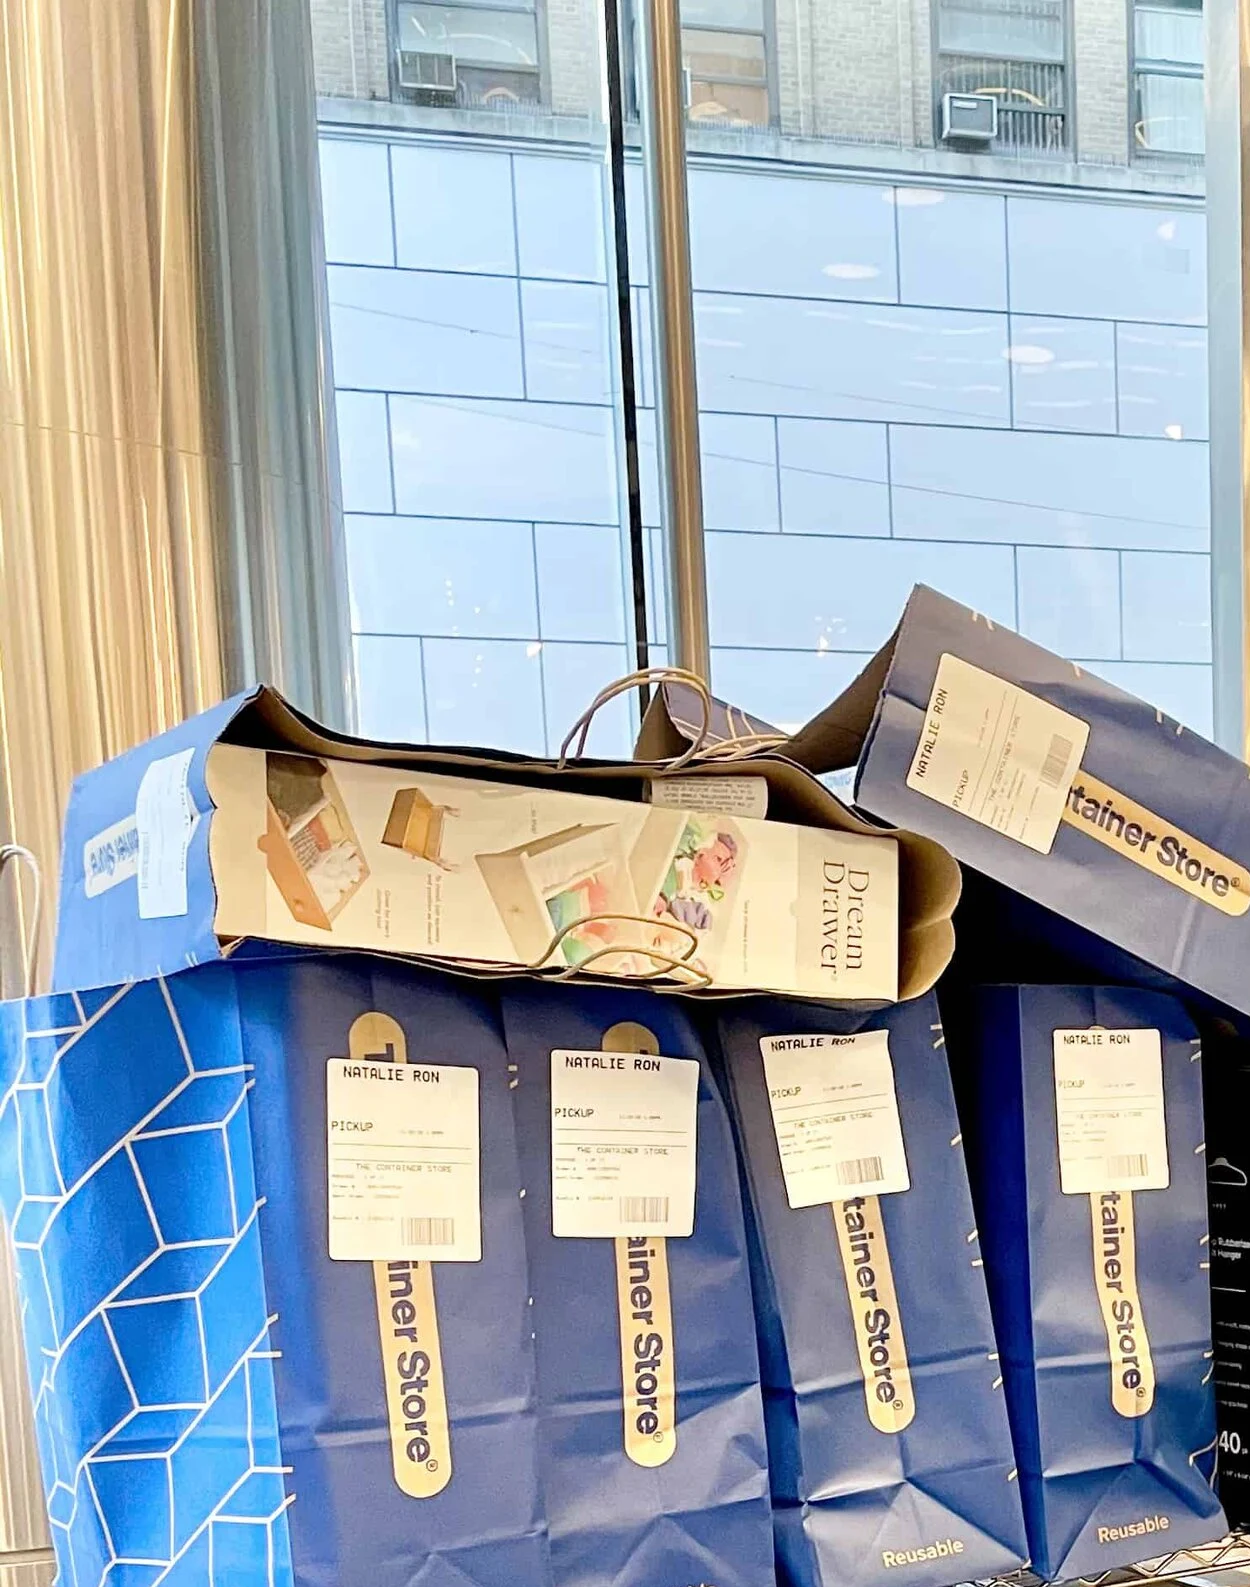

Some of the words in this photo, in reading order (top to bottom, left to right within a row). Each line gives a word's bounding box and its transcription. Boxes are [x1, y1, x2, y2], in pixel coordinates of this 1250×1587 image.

[915, 720, 940, 778] NATALIE
[933, 688, 949, 715] RON
[952, 769, 969, 808] PICKUP
[1066, 785, 1156, 853] tainer
[846, 869, 870, 970] Dream
[771, 1038, 824, 1051] NATALIE
[831, 1037, 856, 1046] RON
[1063, 1035, 1103, 1045] NATALIE
[1109, 1034, 1131, 1044] RON
[344, 1066, 404, 1082] NATALIE
[413, 1070, 440, 1083] RON
[565, 1056, 626, 1070] NATALIE
[634, 1060, 661, 1072] RON
[771, 1086, 802, 1099] PICKUP
[554, 1107, 595, 1118] PICKUP
[331, 1121, 374, 1132] PICKUP
[388, 1261, 419, 1343] iner
[1219, 1430, 1241, 1454] 40
[1098, 1515, 1170, 1544] Reusable
[882, 1538, 965, 1568] Reusable
